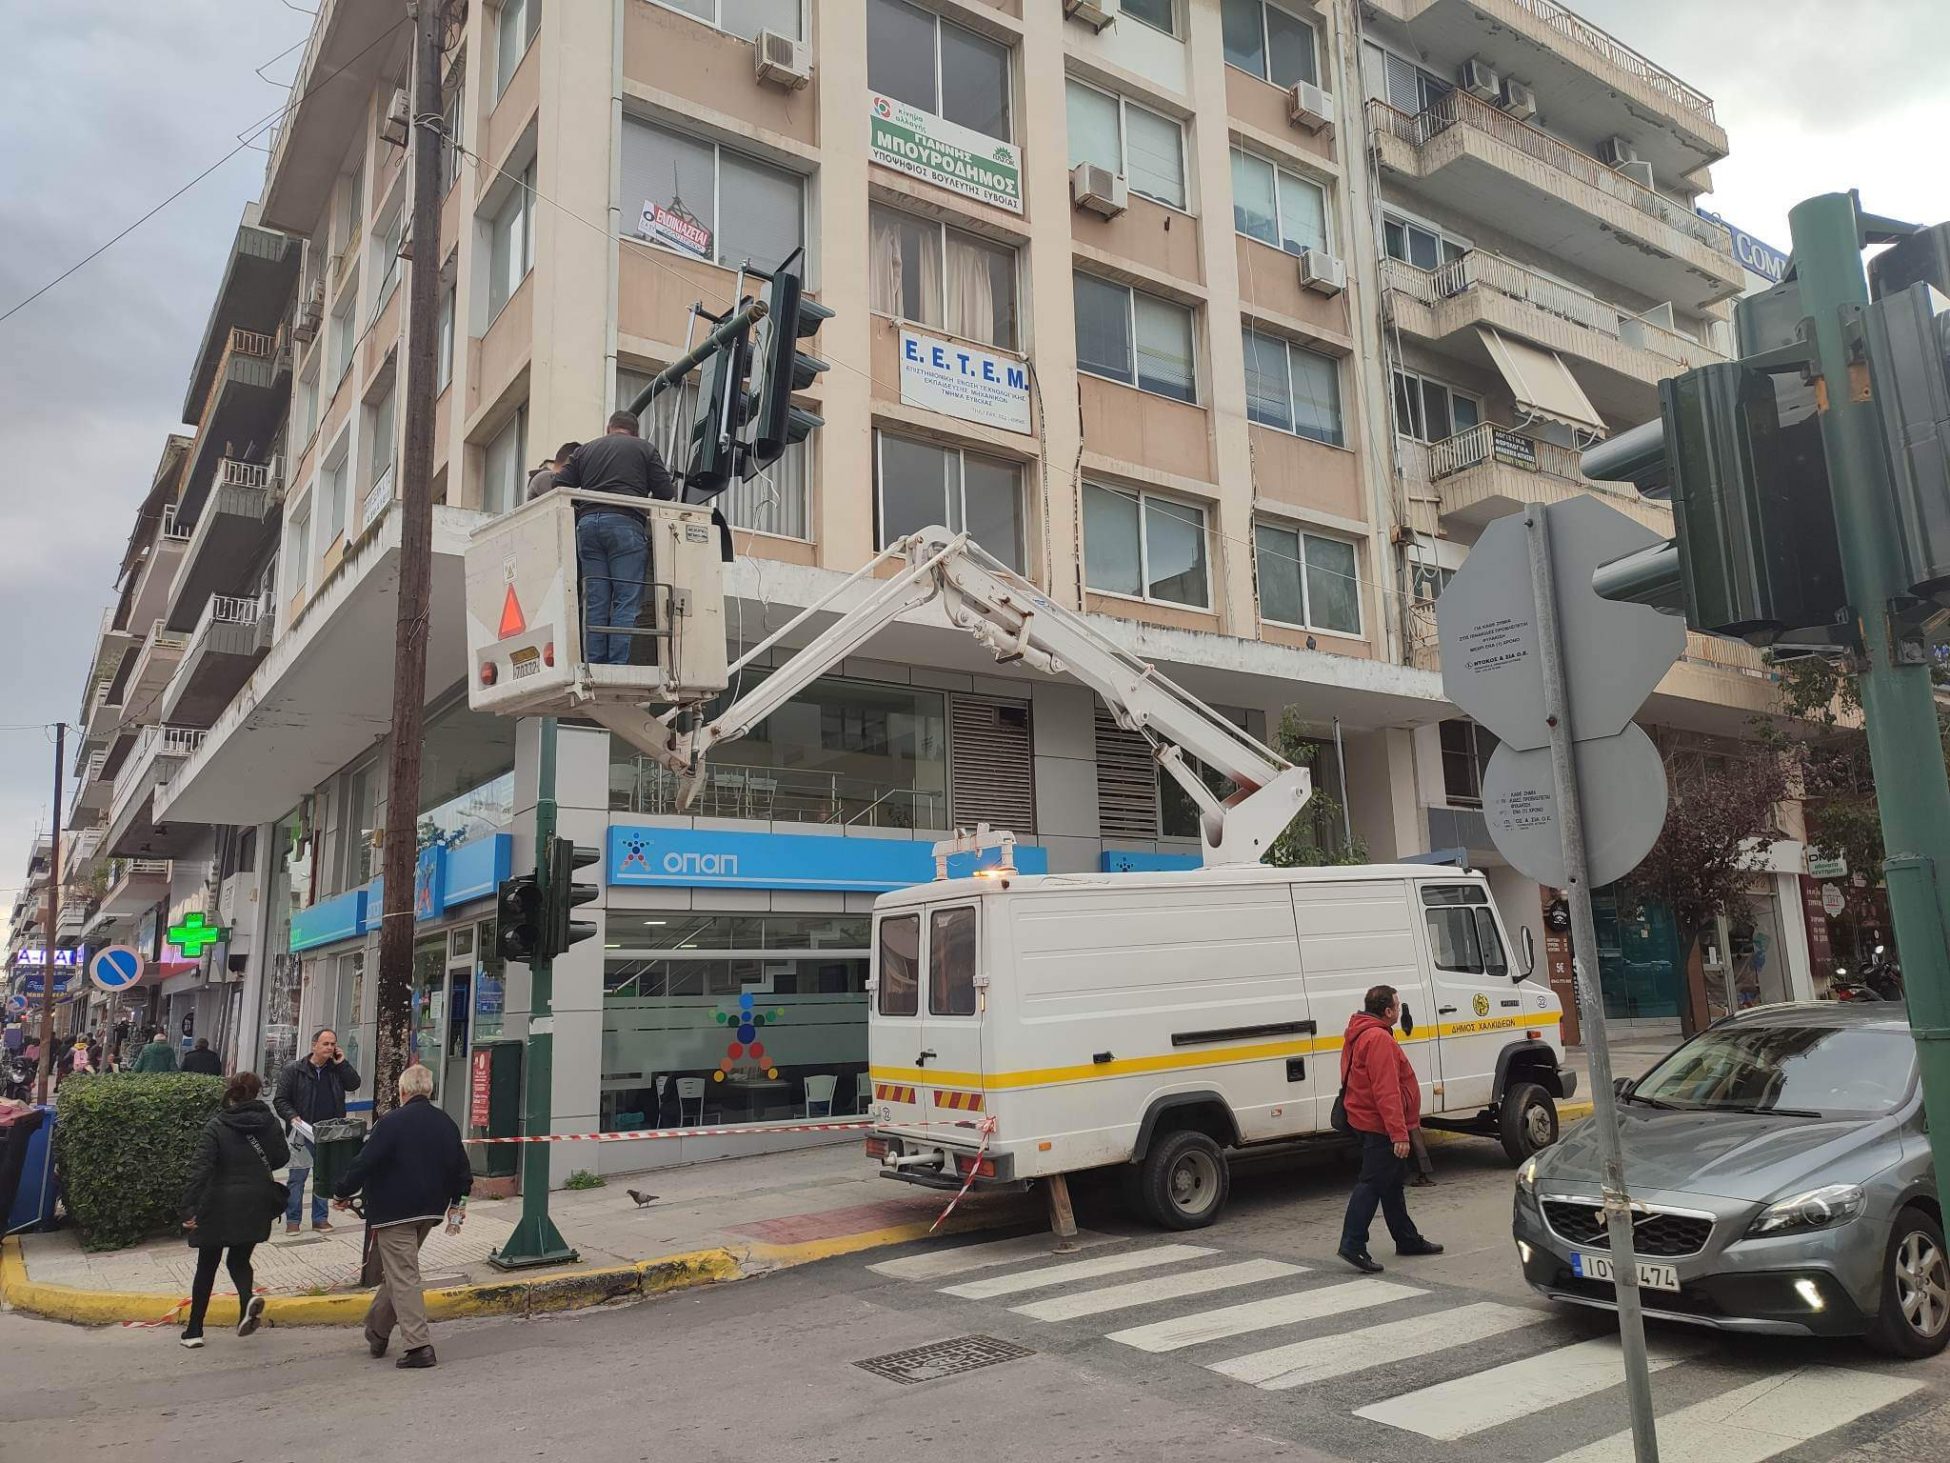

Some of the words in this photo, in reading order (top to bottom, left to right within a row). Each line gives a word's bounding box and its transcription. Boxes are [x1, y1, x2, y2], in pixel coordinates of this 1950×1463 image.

[877, 130, 1016, 194] ΜΠΟΥΡΟΔΗΜΟΣ
[914, 132, 973, 163] ΓΙΑΝΝΗΣ
[873, 149, 928, 177] ΥΠΟΨΗΦΙΟΣ
[931, 171, 981, 195] ΒΟΥΛΕΥΤΗΣ
[983, 188, 1019, 209] ΕΥΒΟΙΑΣ
[1452, 1024, 1476, 1034] ΔΗΜΟΣ
[1479, 1018, 1516, 1030] ΧΑΛΚΙΔΕΩΝ
